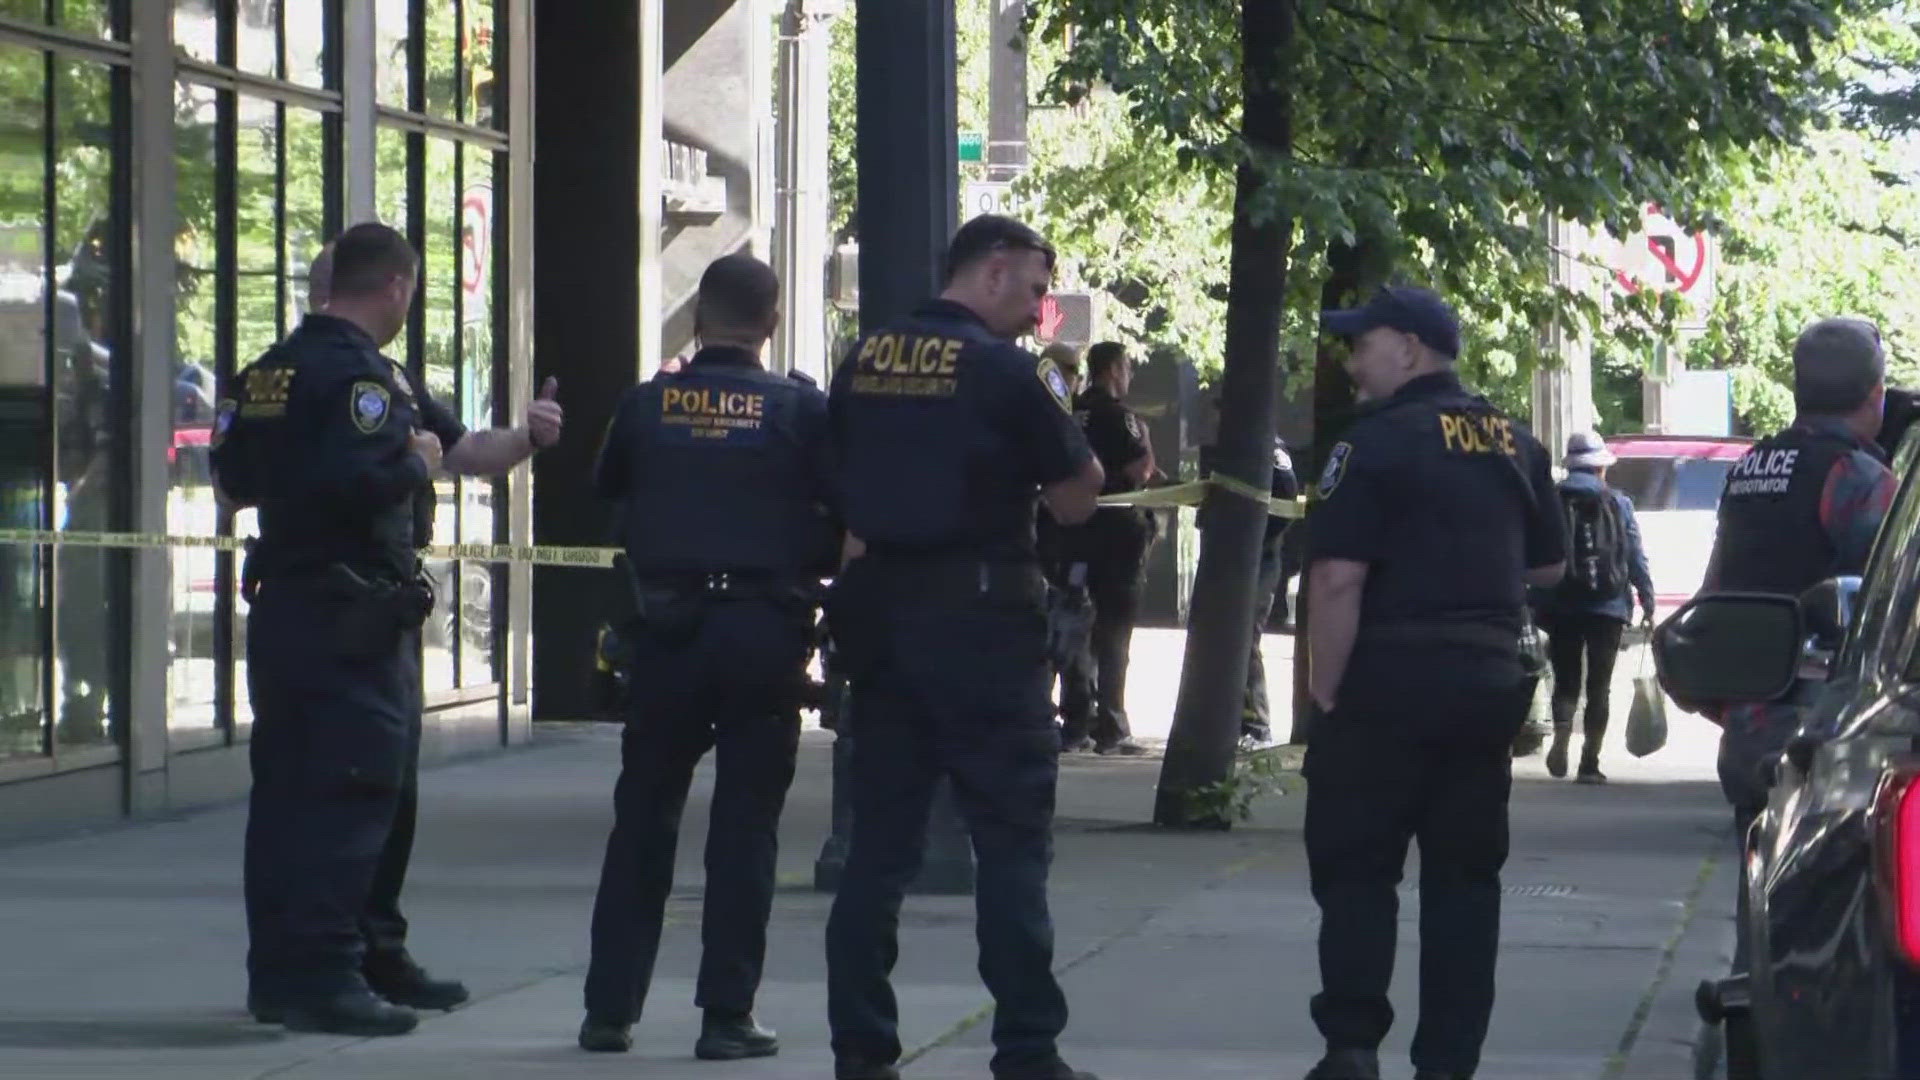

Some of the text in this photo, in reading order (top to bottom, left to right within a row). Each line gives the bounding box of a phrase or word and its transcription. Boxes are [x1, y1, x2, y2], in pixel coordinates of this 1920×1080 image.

[857, 334, 963, 374] POLICE
[663, 387, 764, 416] POLICE
[1439, 413, 1516, 456] POLICE
[1732, 448, 1799, 476] POLICE
[1728, 478, 1789, 496] NEGOTIATOR
